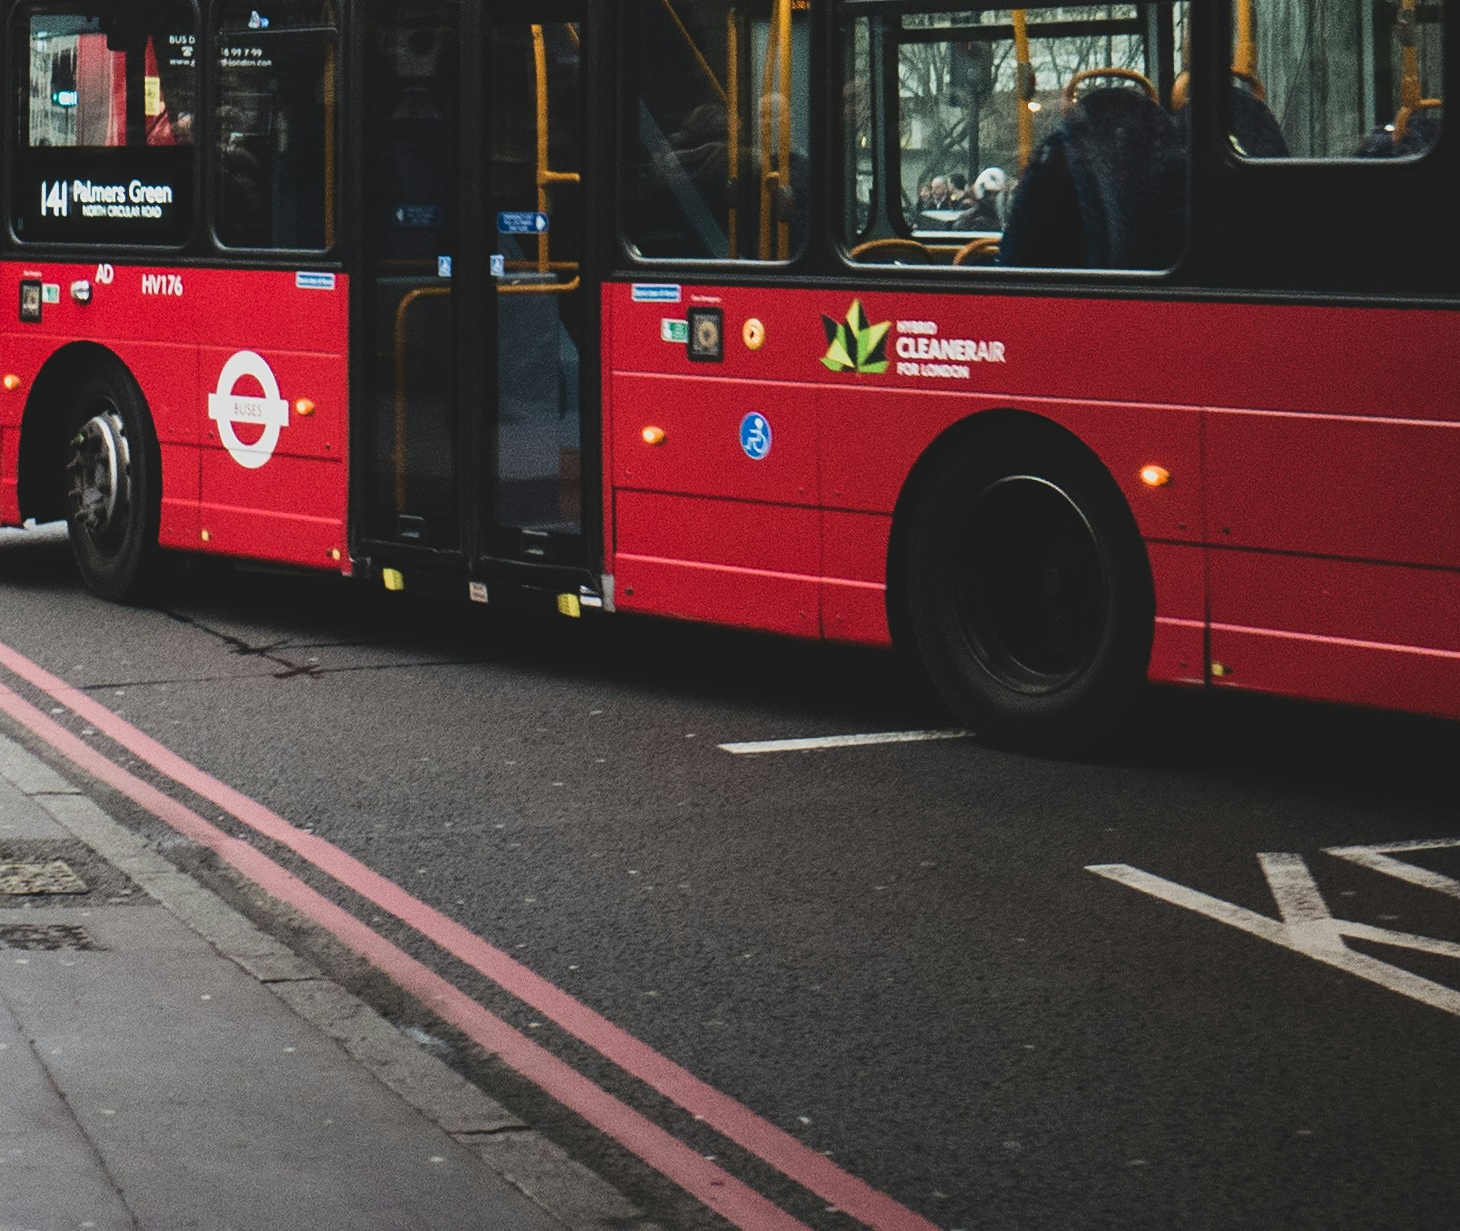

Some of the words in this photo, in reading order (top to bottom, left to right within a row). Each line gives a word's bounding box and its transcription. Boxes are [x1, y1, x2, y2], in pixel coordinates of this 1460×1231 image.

[40, 179, 68, 217] 141
[72, 179, 126, 204] Palmers
[128, 178, 173, 204] Green
[94, 263, 115, 284] AD
[141, 272, 184, 297] HV176
[896, 361, 920, 377] FOR
[920, 363, 971, 380] LONDON
[232, 402, 263, 418] BUSES
